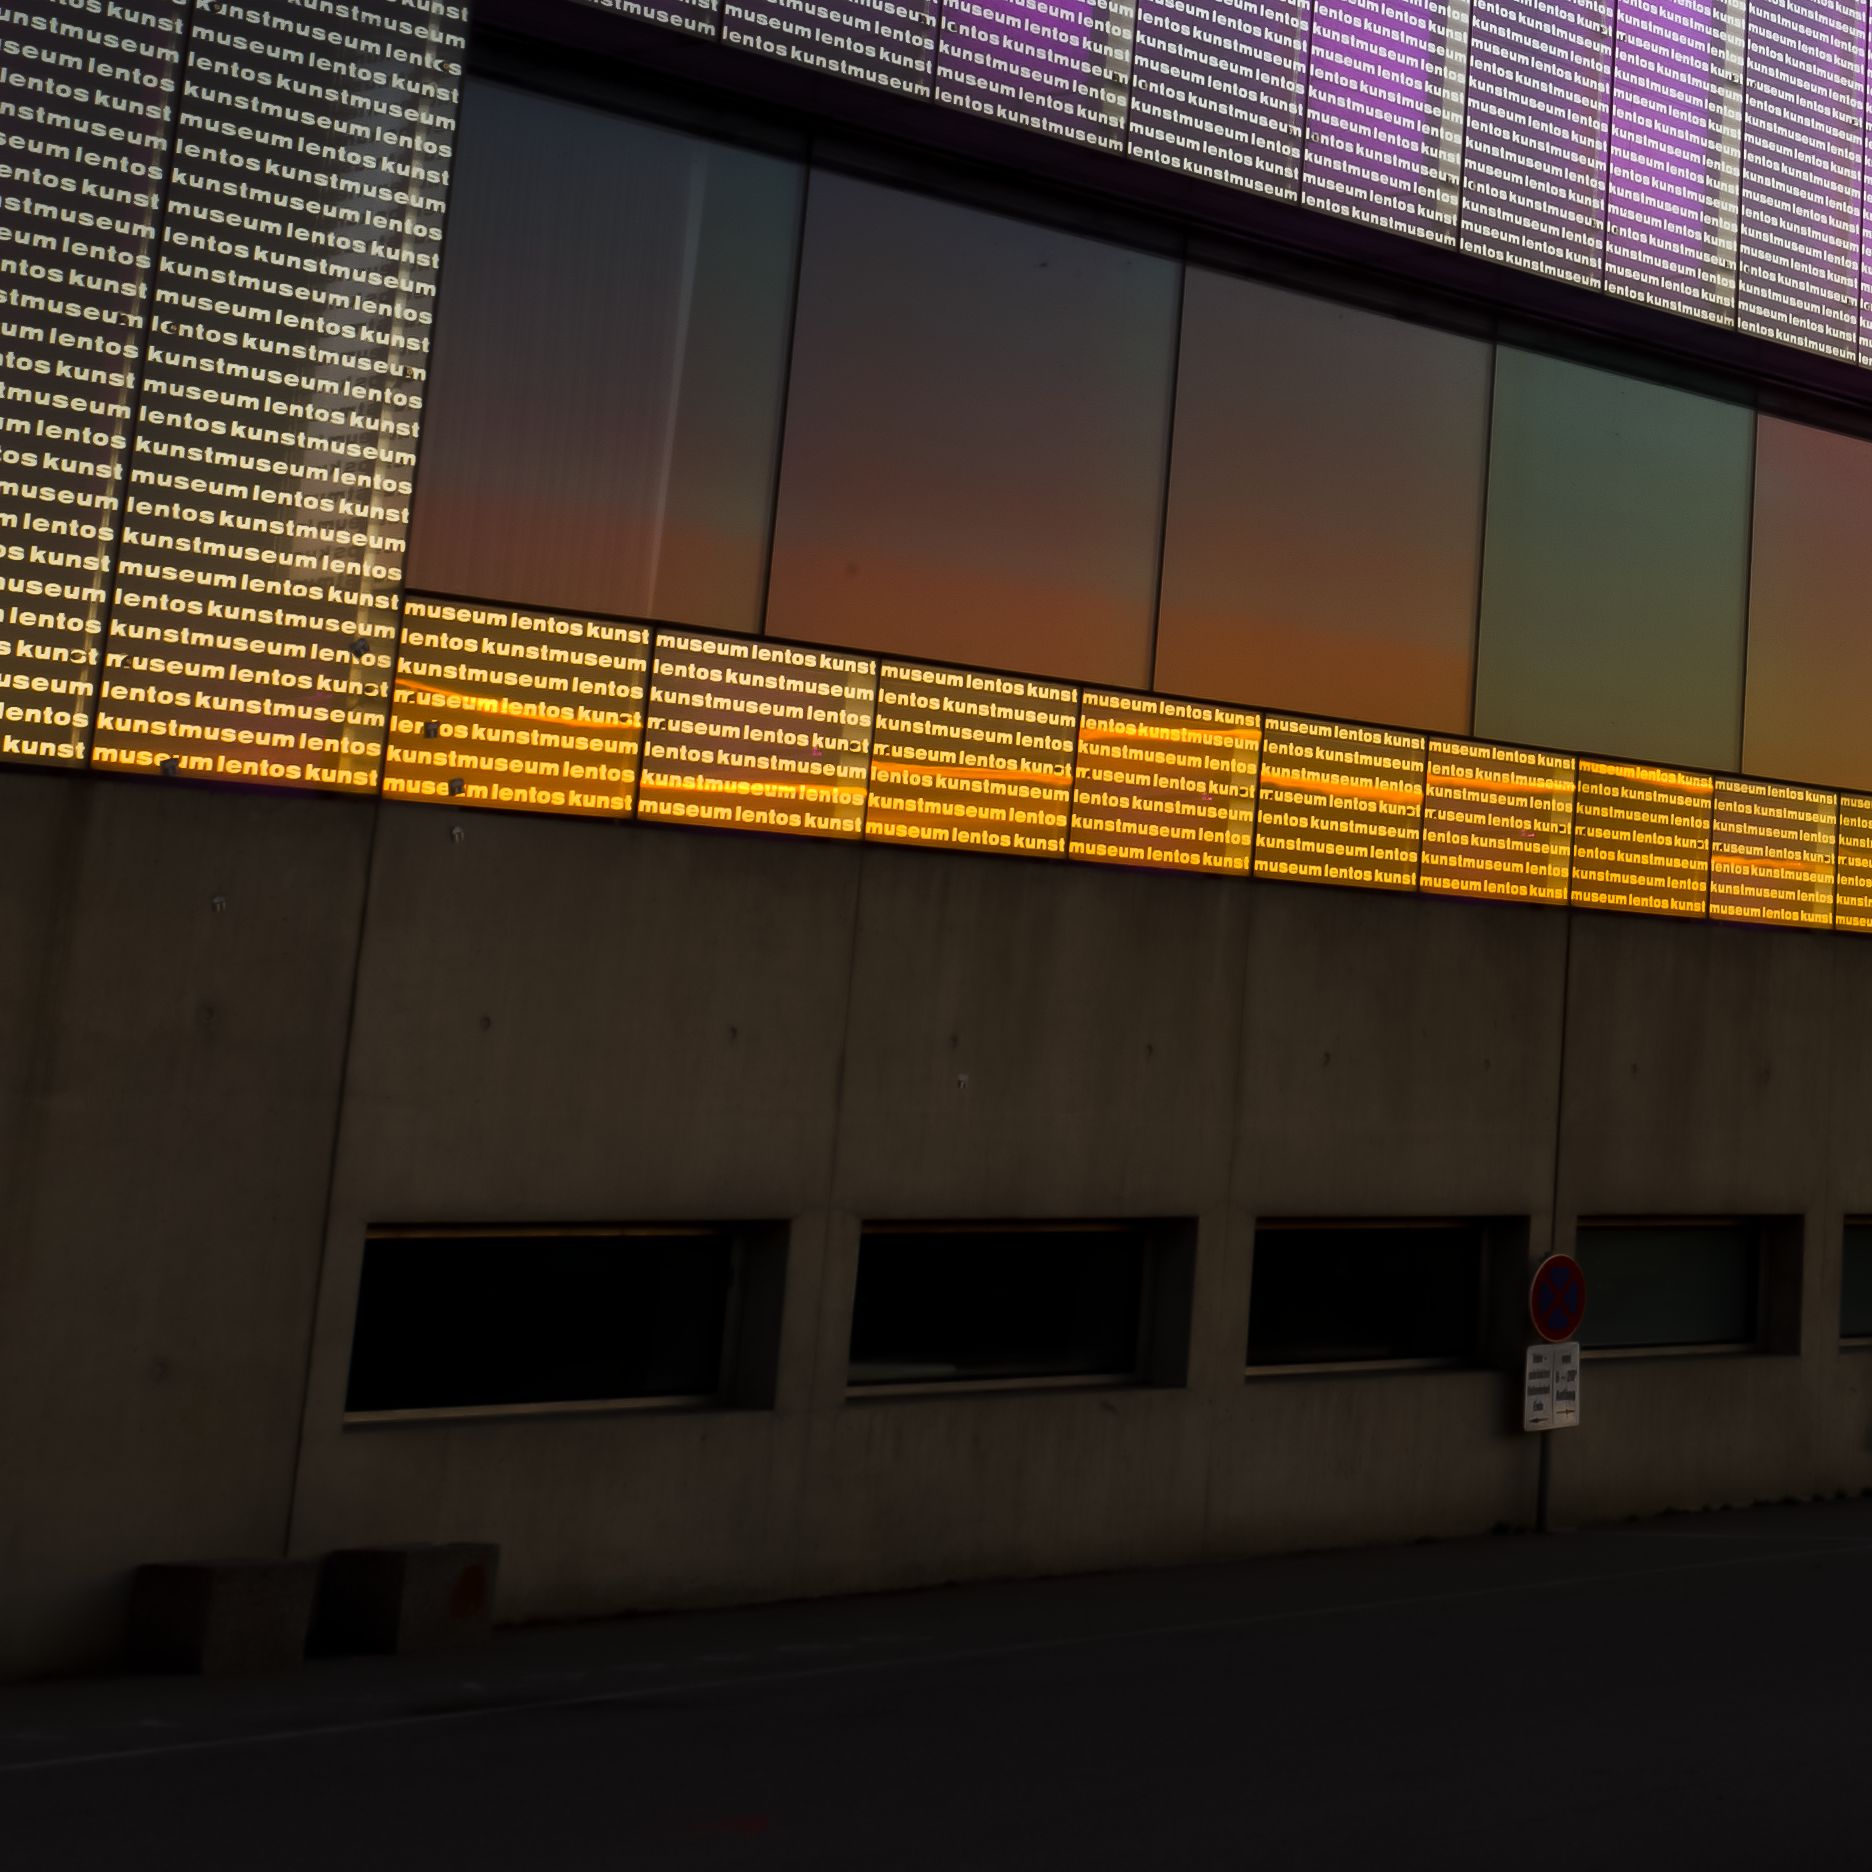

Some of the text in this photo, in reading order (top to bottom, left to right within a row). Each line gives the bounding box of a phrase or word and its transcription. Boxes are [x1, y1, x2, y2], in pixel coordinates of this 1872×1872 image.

[192, 27, 458, 100] museum lentos kunst
[188, 53, 454, 128] lentos kunstmuseum
[184, 82, 451, 155] kunstmuseum lentos
[180, 113, 448, 183] museum lentos kunst
[176, 139, 445, 210] lentos kunstmuseum
[1305, 148, 1459, 205] kunstmuseum lentos
[172, 168, 442, 238] kunstmuseum lentos
[1302, 190, 1456, 246] lentos kunstmuseum
[1304, 171, 1457, 226] museum lentos kunst
[168, 200, 439, 266] museum lentos kunst
[164, 227, 436, 294] lentos kunstmuseum
[161, 256, 432, 322] kunstmuseum lentos
[148, 345, 423, 407] kunstmuseum lentos
[144, 378, 419, 435] museum lentos kunst
[140, 405, 416, 464] lentos kunstmuseum
[136, 436, 413, 493] kunstmuseum lentos
[132, 469, 410, 522] museum lentos kunst
[128, 496, 406, 551] lentos kunstmuseum
[124, 527, 403, 580] kunstmuseum lentos
[404, 602, 648, 646] museum lentos kunst
[401, 628, 646, 673] lentos kunstmuseum
[656, 636, 875, 676] museum lentos kunst
[398, 657, 643, 701] kunstmuseum lentos
[653, 660, 873, 702] lentos kunstmuseum
[881, 666, 1077, 704] museum lentos kunst
[650, 687, 871, 727] kunstmuseum lentos
[879, 689, 1075, 728] lentos kunstmuseum
[1083, 695, 1260, 728] museum lentos kunst
[876, 715, 1074, 752] kunstmuseum lentos
[644, 742, 866, 779] lentos kunstmuseum
[639, 799, 862, 831] museum lentos kunst
[868, 793, 1068, 826] kunstmuseum lentos
[1074, 790, 1254, 822] lentos kunstmuseum
[1258, 811, 1420, 840] lentos kunstmuseum
[865, 822, 1066, 851] museum lentos kunst
[1072, 815, 1252, 846] kunstmuseum lentos
[1256, 834, 1418, 863] kunstmuseum lentos
[1069, 842, 1250, 870] museum lentos kunst
[1254, 861, 1417, 885] museum lentos kunst
